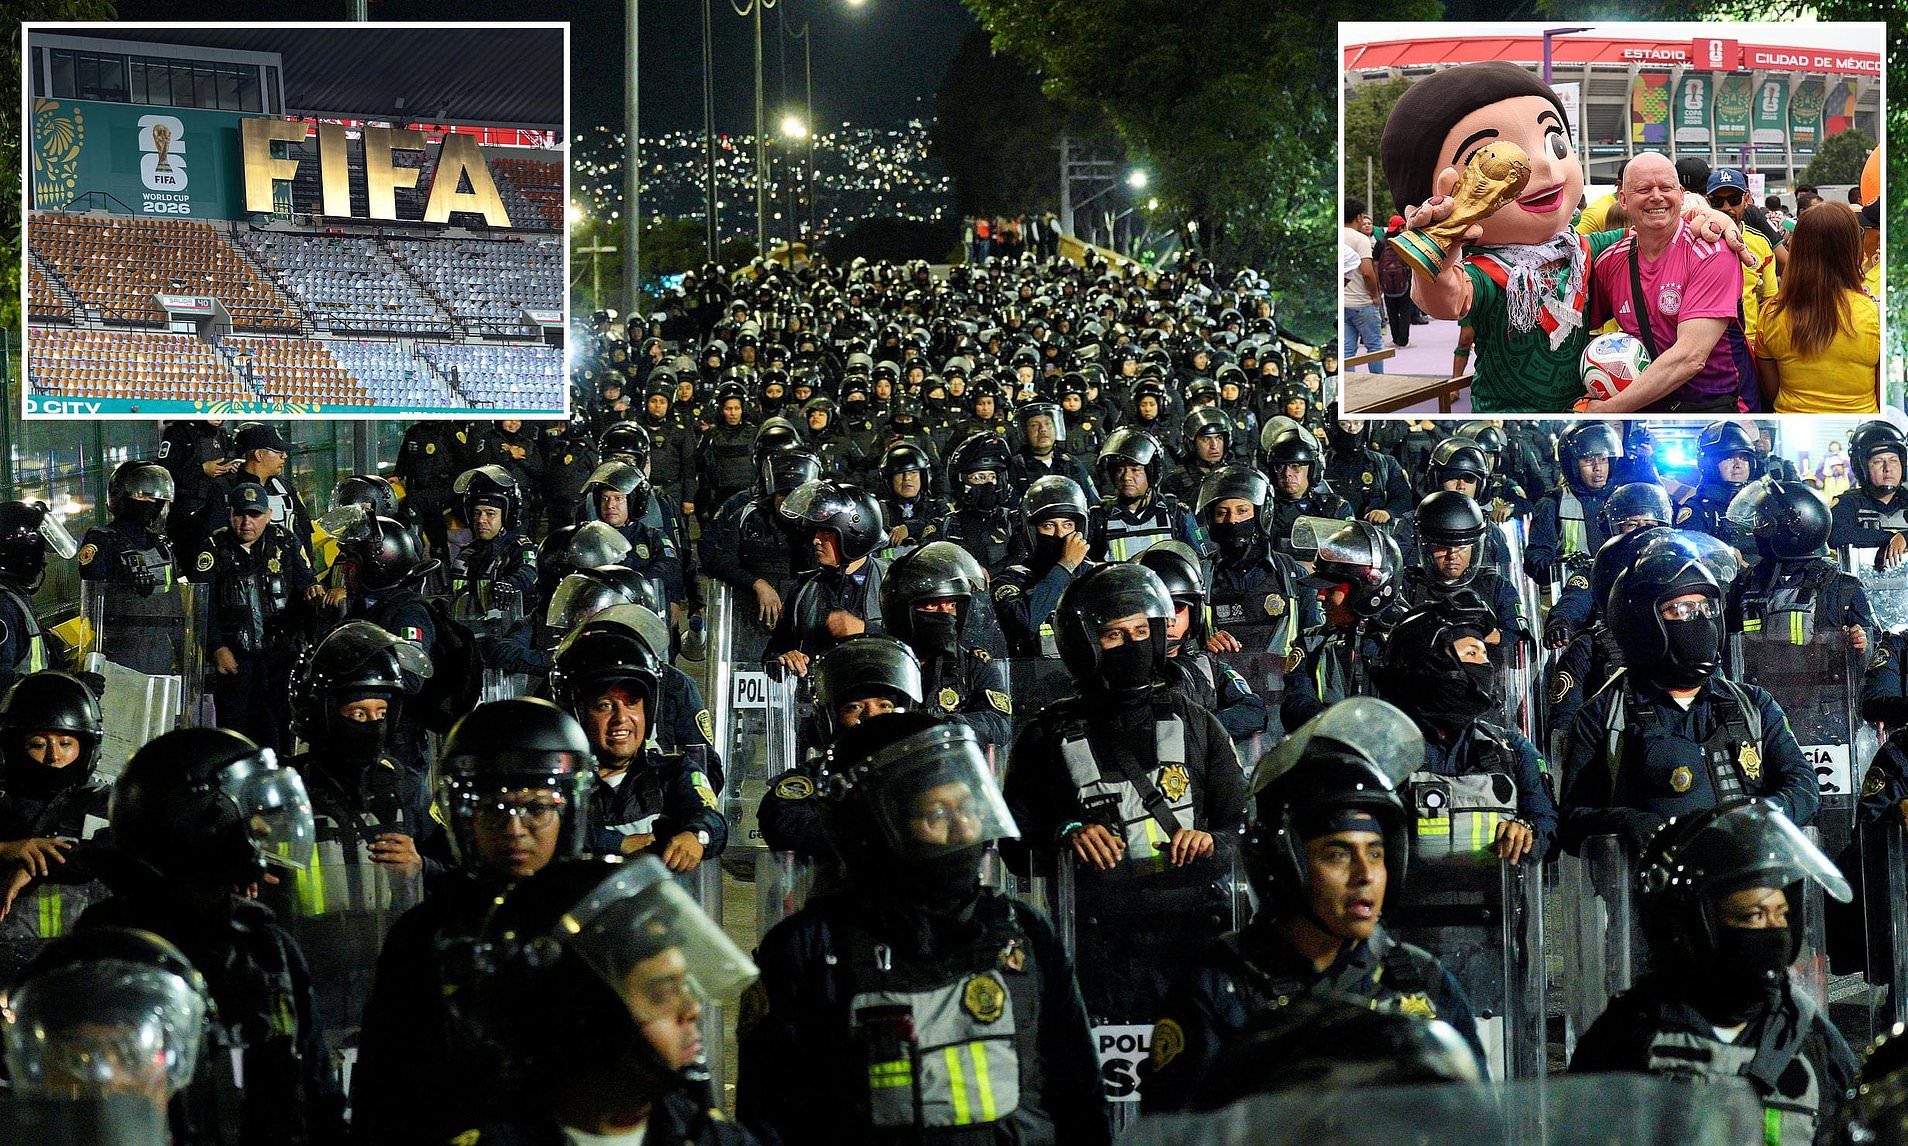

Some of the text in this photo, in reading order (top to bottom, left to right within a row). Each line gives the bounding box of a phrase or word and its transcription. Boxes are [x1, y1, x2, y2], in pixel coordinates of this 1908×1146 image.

[1624, 49, 1686, 60] ESTADIO
[1755, 53, 1809, 66] CIUDAD
[1814, 57, 1832, 68] DE
[154, 175, 177, 185] FIFA
[241, 118, 513, 228] FIFA
[142, 193, 172, 201] WORLD
[143, 201, 191, 214] 2026
[43, 400, 102, 414] CITY
[737, 678, 765, 703] POL
[1099, 1034, 1152, 1053] POL
